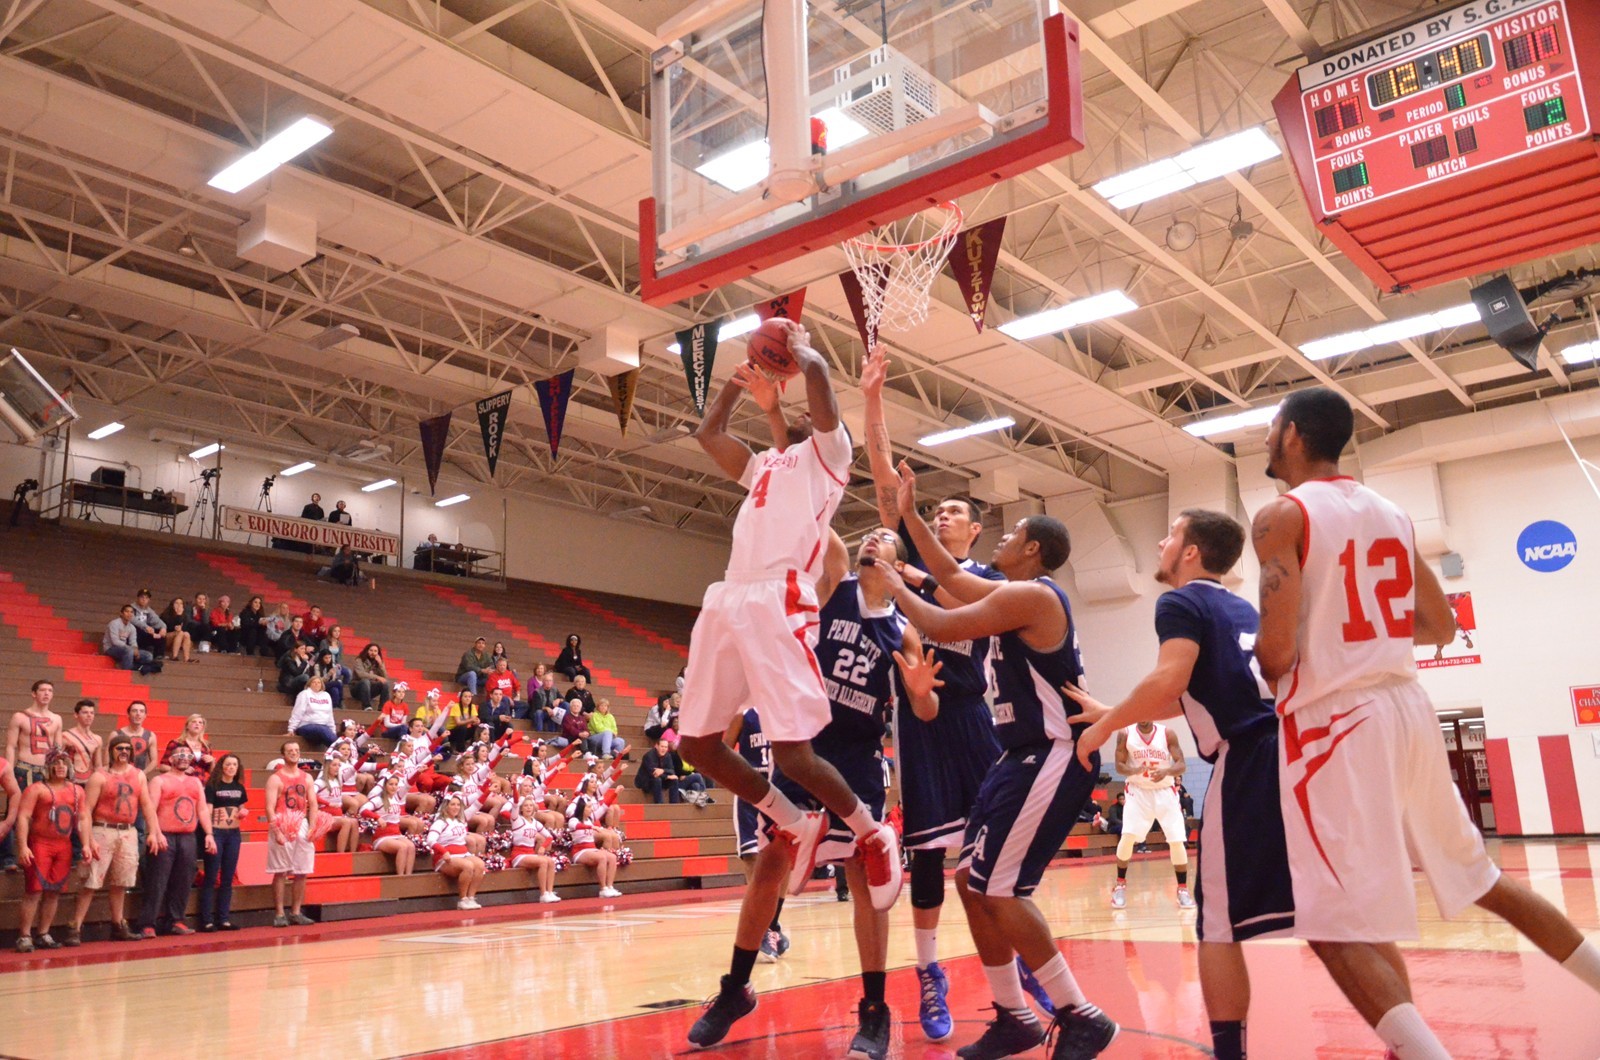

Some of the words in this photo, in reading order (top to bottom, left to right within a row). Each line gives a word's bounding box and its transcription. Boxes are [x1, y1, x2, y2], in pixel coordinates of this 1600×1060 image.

[1494, 5, 1559, 40] VISITOR
[1323, 31, 1416, 77] DONATED
[1426, 16, 1452, 37] BY
[1503, 65, 1545, 90] BONUS
[1310, 78, 1361, 108] HOME
[1520, 83, 1561, 107] FOULS
[1406, 101, 1443, 122] PERIOD
[1452, 107, 1490, 129] FOULS
[1335, 125, 1371, 148] BONUS
[1399, 122, 1443, 147] PLAYER
[1525, 122, 1572, 148] POINTS
[1330, 149, 1364, 170] FOULS
[1427, 156, 1467, 179] MATCH
[1334, 186, 1374, 208] POINTS
[965, 227, 985, 322] KUTZTOWN
[478, 392, 511, 414] SLIPPERY
[488, 412, 499, 458] ROCK
[752, 470, 771, 508] 4
[249, 515, 319, 542] EDINBORO
[322, 528, 396, 553] UNIVERSITY
[1525, 541, 1576, 562] NCAA
[1339, 538, 1413, 642] 12
[827, 619, 861, 644] PENN
[833, 648, 870, 686] 22
